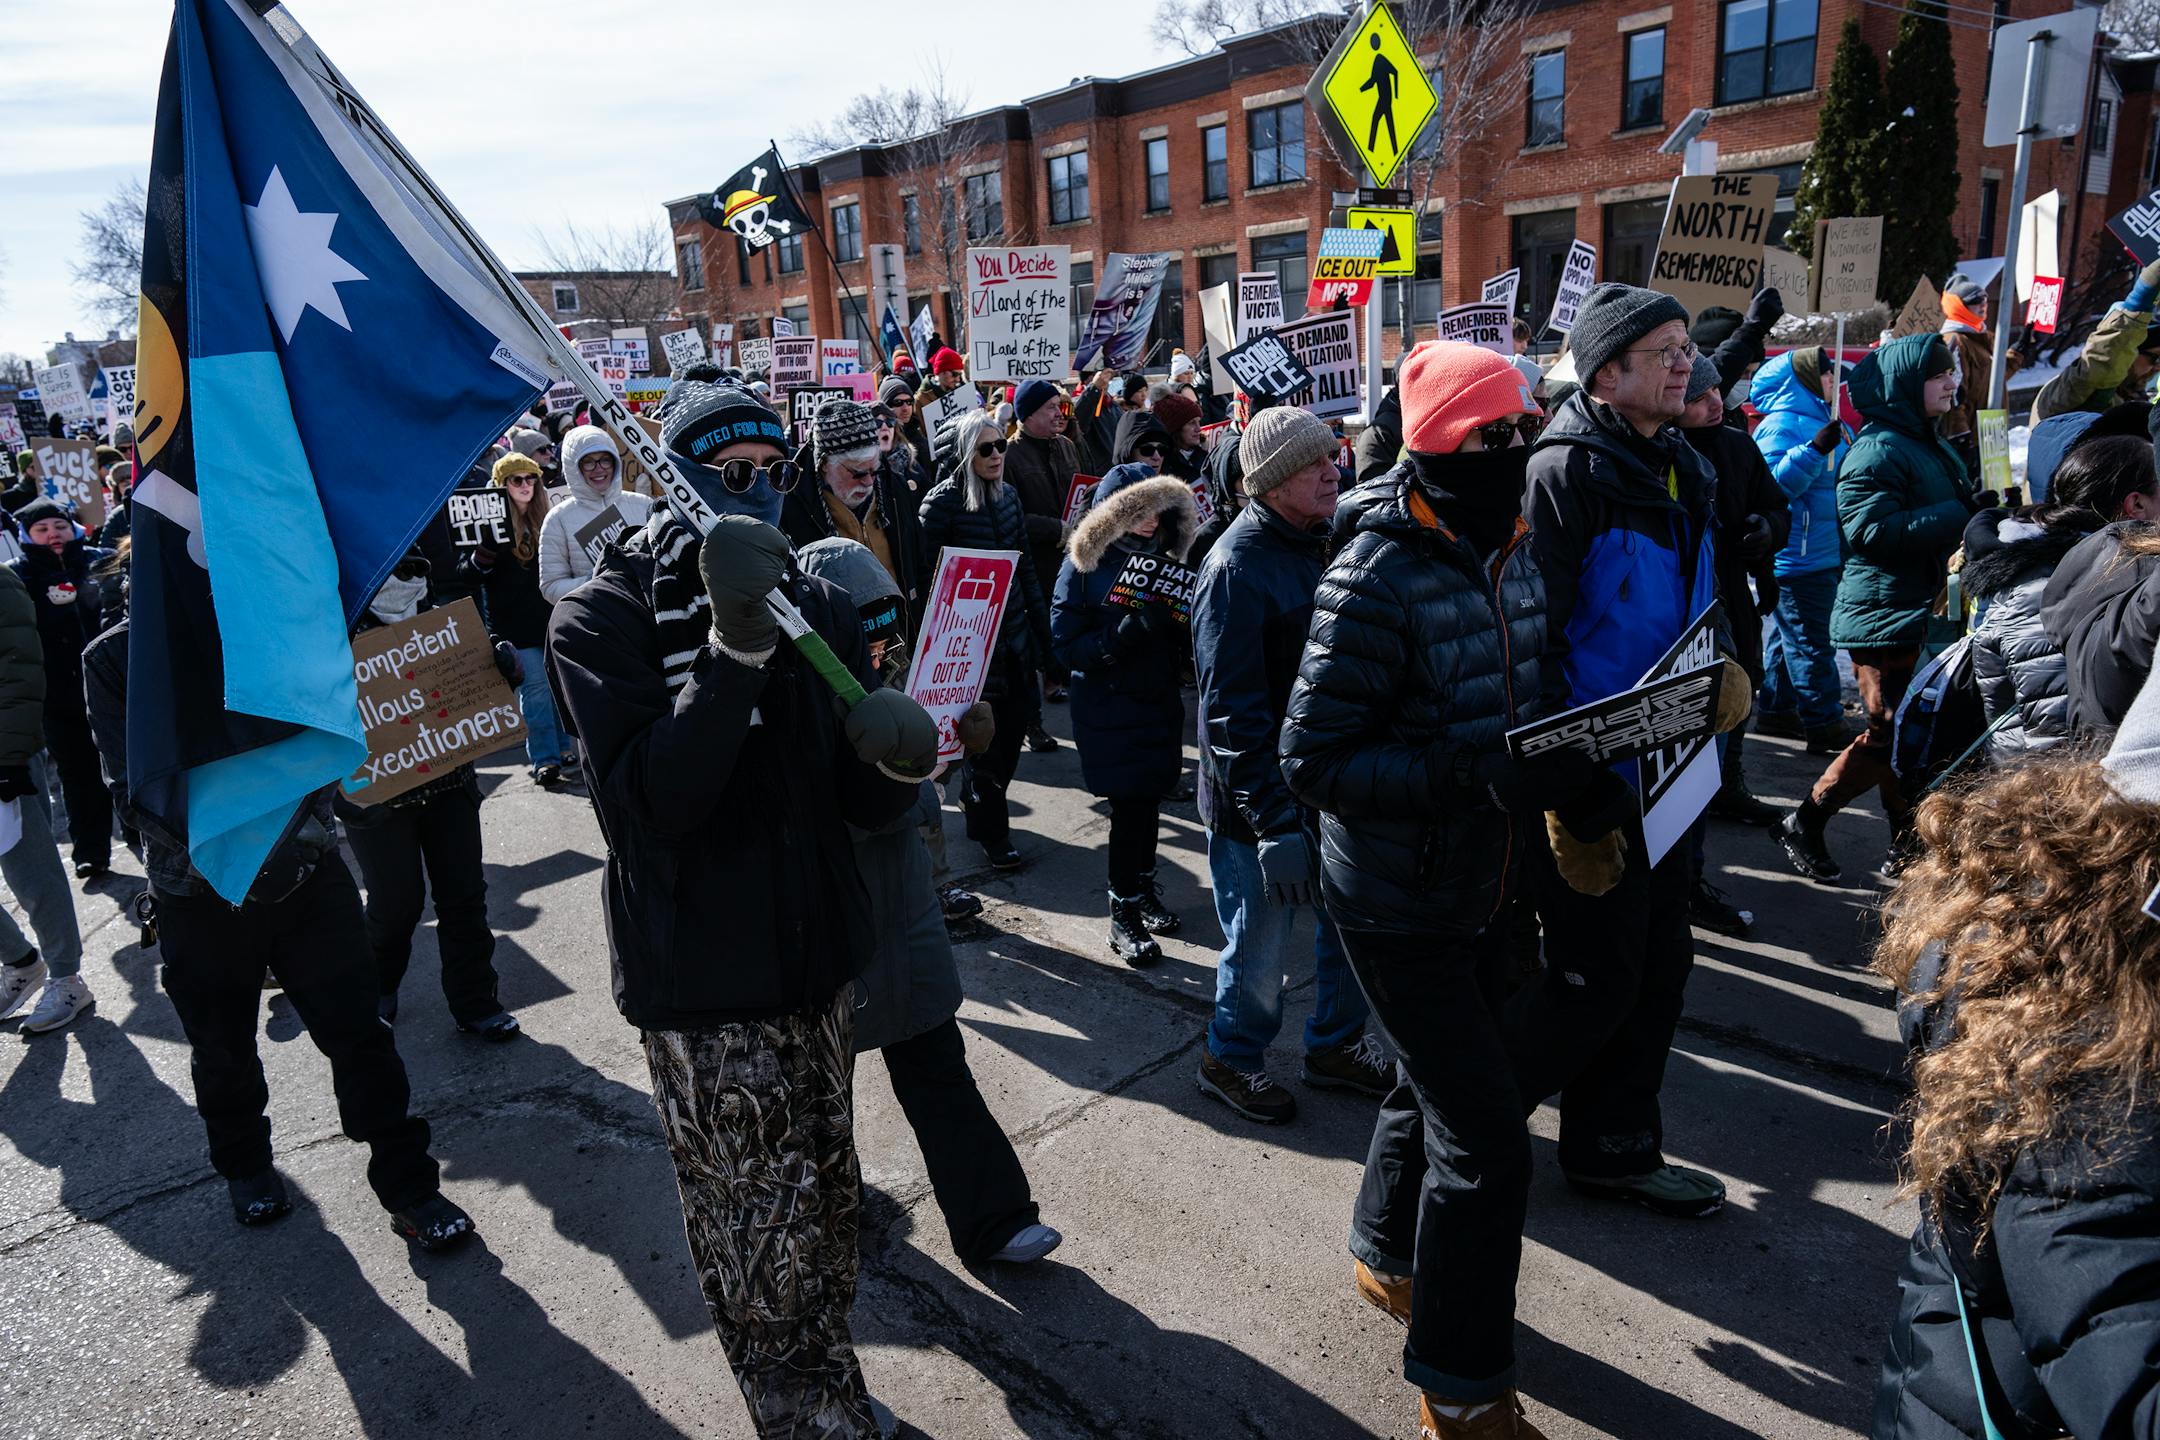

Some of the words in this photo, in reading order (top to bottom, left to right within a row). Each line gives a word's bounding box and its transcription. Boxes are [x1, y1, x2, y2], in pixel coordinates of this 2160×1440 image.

[1711, 176, 1752, 196] THE
[1672, 202, 1765, 244] NORTH
[1829, 224, 1848, 241] WE
[1852, 221, 1871, 237] ARE
[1008, 251, 1058, 276] Decide
[1122, 255, 1163, 271] Stephen
[1315, 259, 1341, 278] ICE
[1342, 259, 1377, 278] OUT
[1569, 250, 1590, 271] NO
[1654, 250, 1759, 288] REMEMBERS
[1840, 262, 1855, 274] NO
[1124, 272, 1154, 284] Miller
[1823, 276, 1874, 298] SURRENDER
[991, 290, 1021, 312] Land
[1026, 288, 1039, 314] of
[1040, 288, 1066, 309] the
[1124, 288, 1135, 299] is
[1136, 290, 1144, 299] a
[1322, 282, 1359, 303] MSP
[1011, 313, 1048, 333] FREE
[1442, 312, 1508, 336] REMEMBER
[624, 341, 637, 350] NO
[665, 332, 686, 348] OPE!
[755, 339, 769, 348] ICE
[990, 340, 1019, 356] Land
[1023, 338, 1036, 355] of
[1038, 336, 1061, 357] the
[1297, 323, 1349, 350] DEMAND
[742, 352, 756, 360] GO
[758, 351, 770, 359] TO
[775, 344, 813, 356] SOLIDARITY
[823, 347, 858, 358] ABOLISH
[601, 357, 613, 368] WE
[779, 356, 794, 368] WITH
[795, 356, 808, 367] OUR
[1007, 359, 1054, 377] FACISTS
[1228, 336, 1289, 386] ABOLISH
[37, 370, 51, 386] ICE
[60, 369, 70, 380] IS
[603, 368, 626, 379] NO
[774, 370, 812, 383] IMMIGRANT
[1246, 357, 1306, 397] ICE
[609, 383, 622, 391] TO
[1318, 368, 1357, 403] ALL!
[630, 392, 645, 401] ICE
[939, 392, 958, 417] BE
[691, 426, 731, 456] UNITED
[732, 421, 759, 438] FOR
[602, 399, 710, 525] Reebok
[448, 492, 507, 524] ABOLISH
[1118, 570, 1149, 588] NO
[1127, 555, 1157, 572] NO
[1160, 563, 1198, 587] HAT
[1109, 594, 1145, 610] WELCO
[355, 616, 460, 684] ompetent
[945, 636, 971, 658] I.C.E.
[932, 662, 955, 684] OUT
[955, 661, 972, 683] OF
[915, 685, 975, 707] MINNEAPOLIS
[358, 688, 425, 732] llous
[363, 703, 521, 784] xecutioners
